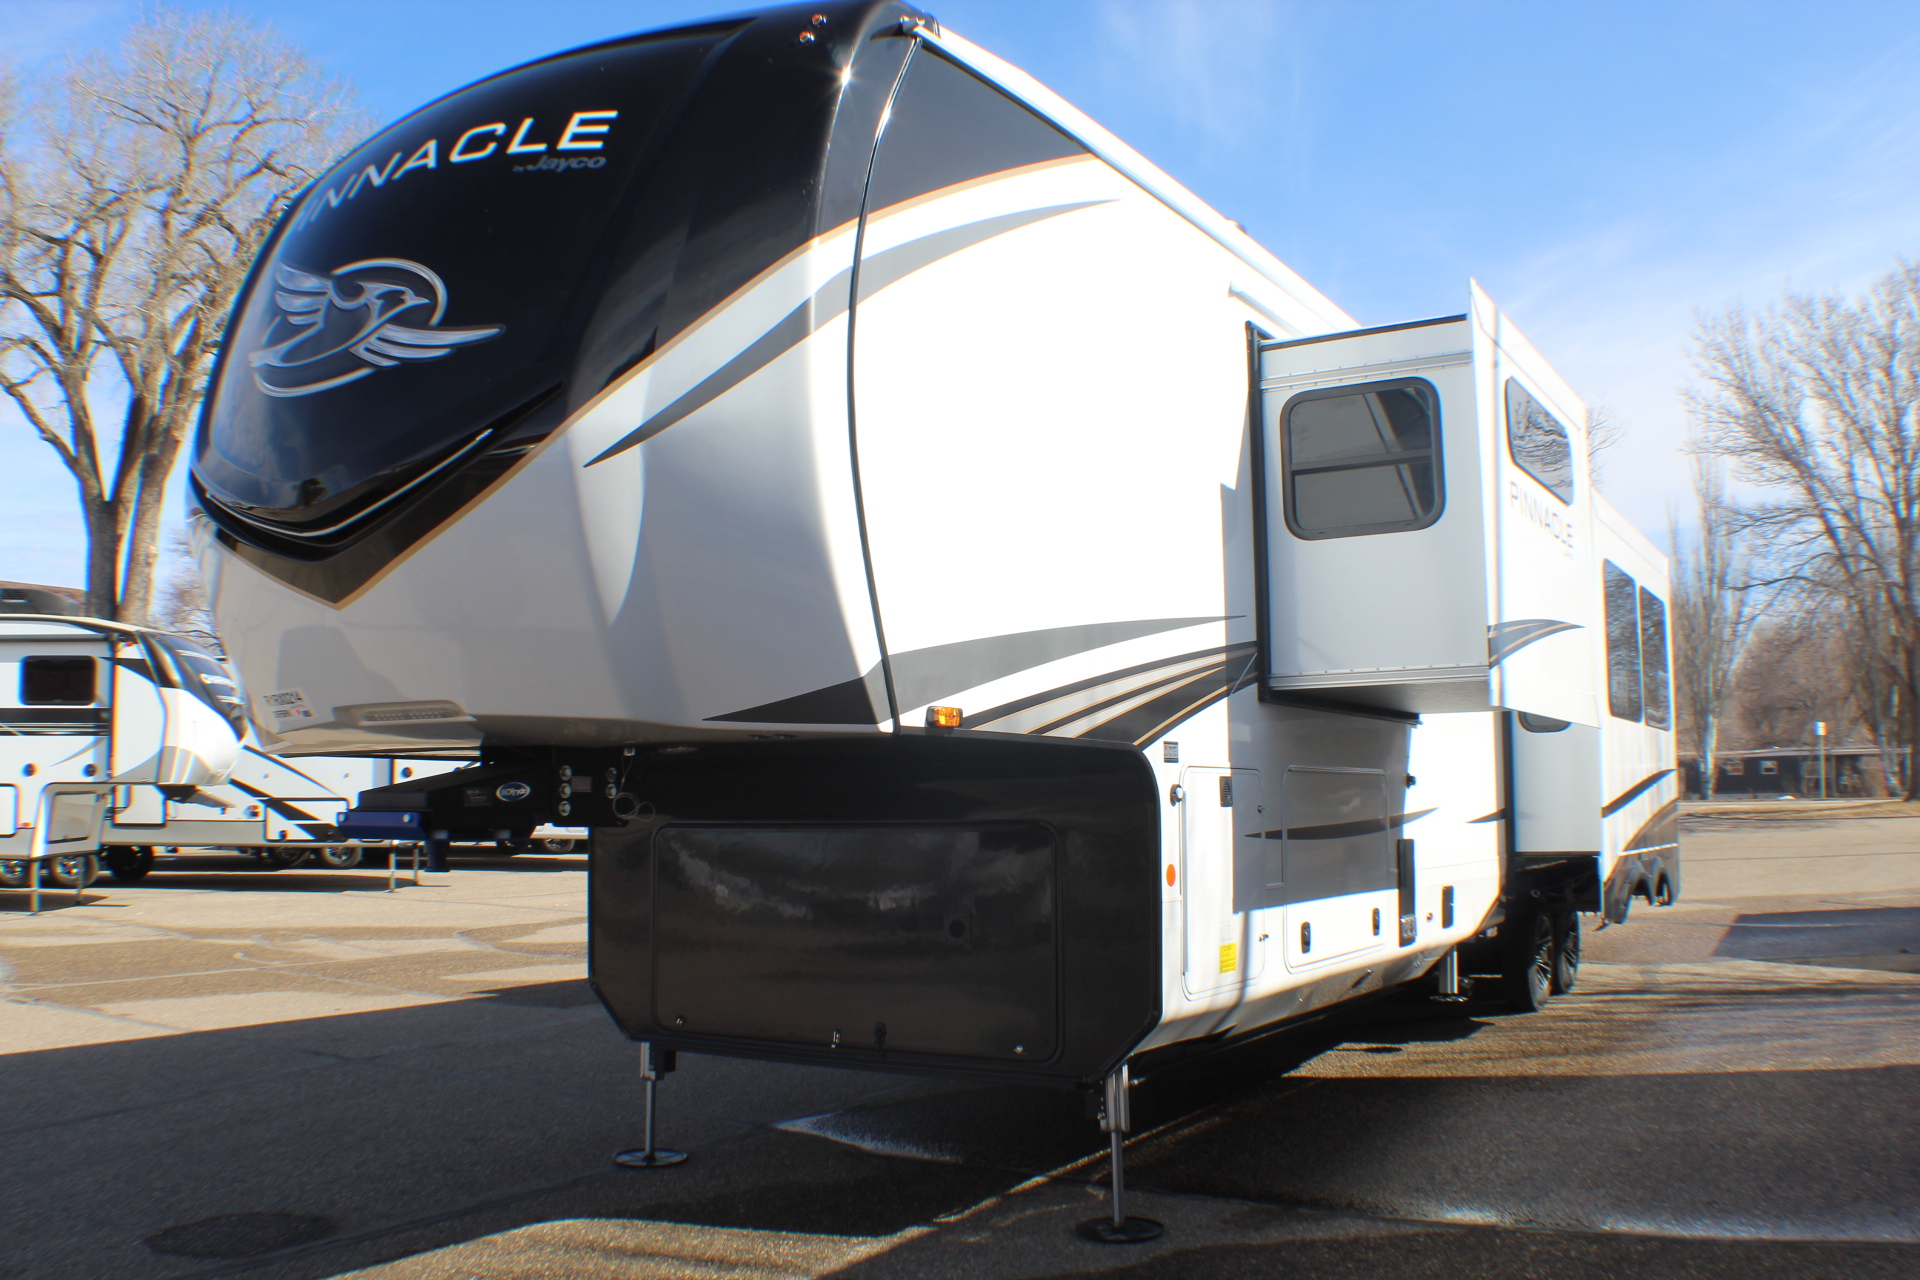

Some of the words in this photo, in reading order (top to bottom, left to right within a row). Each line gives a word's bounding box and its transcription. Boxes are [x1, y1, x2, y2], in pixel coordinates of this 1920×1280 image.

[295, 110, 619, 232] INNACLE
[526, 154, 607, 173] Jayco
[1510, 480, 1574, 549] PINNACLE
